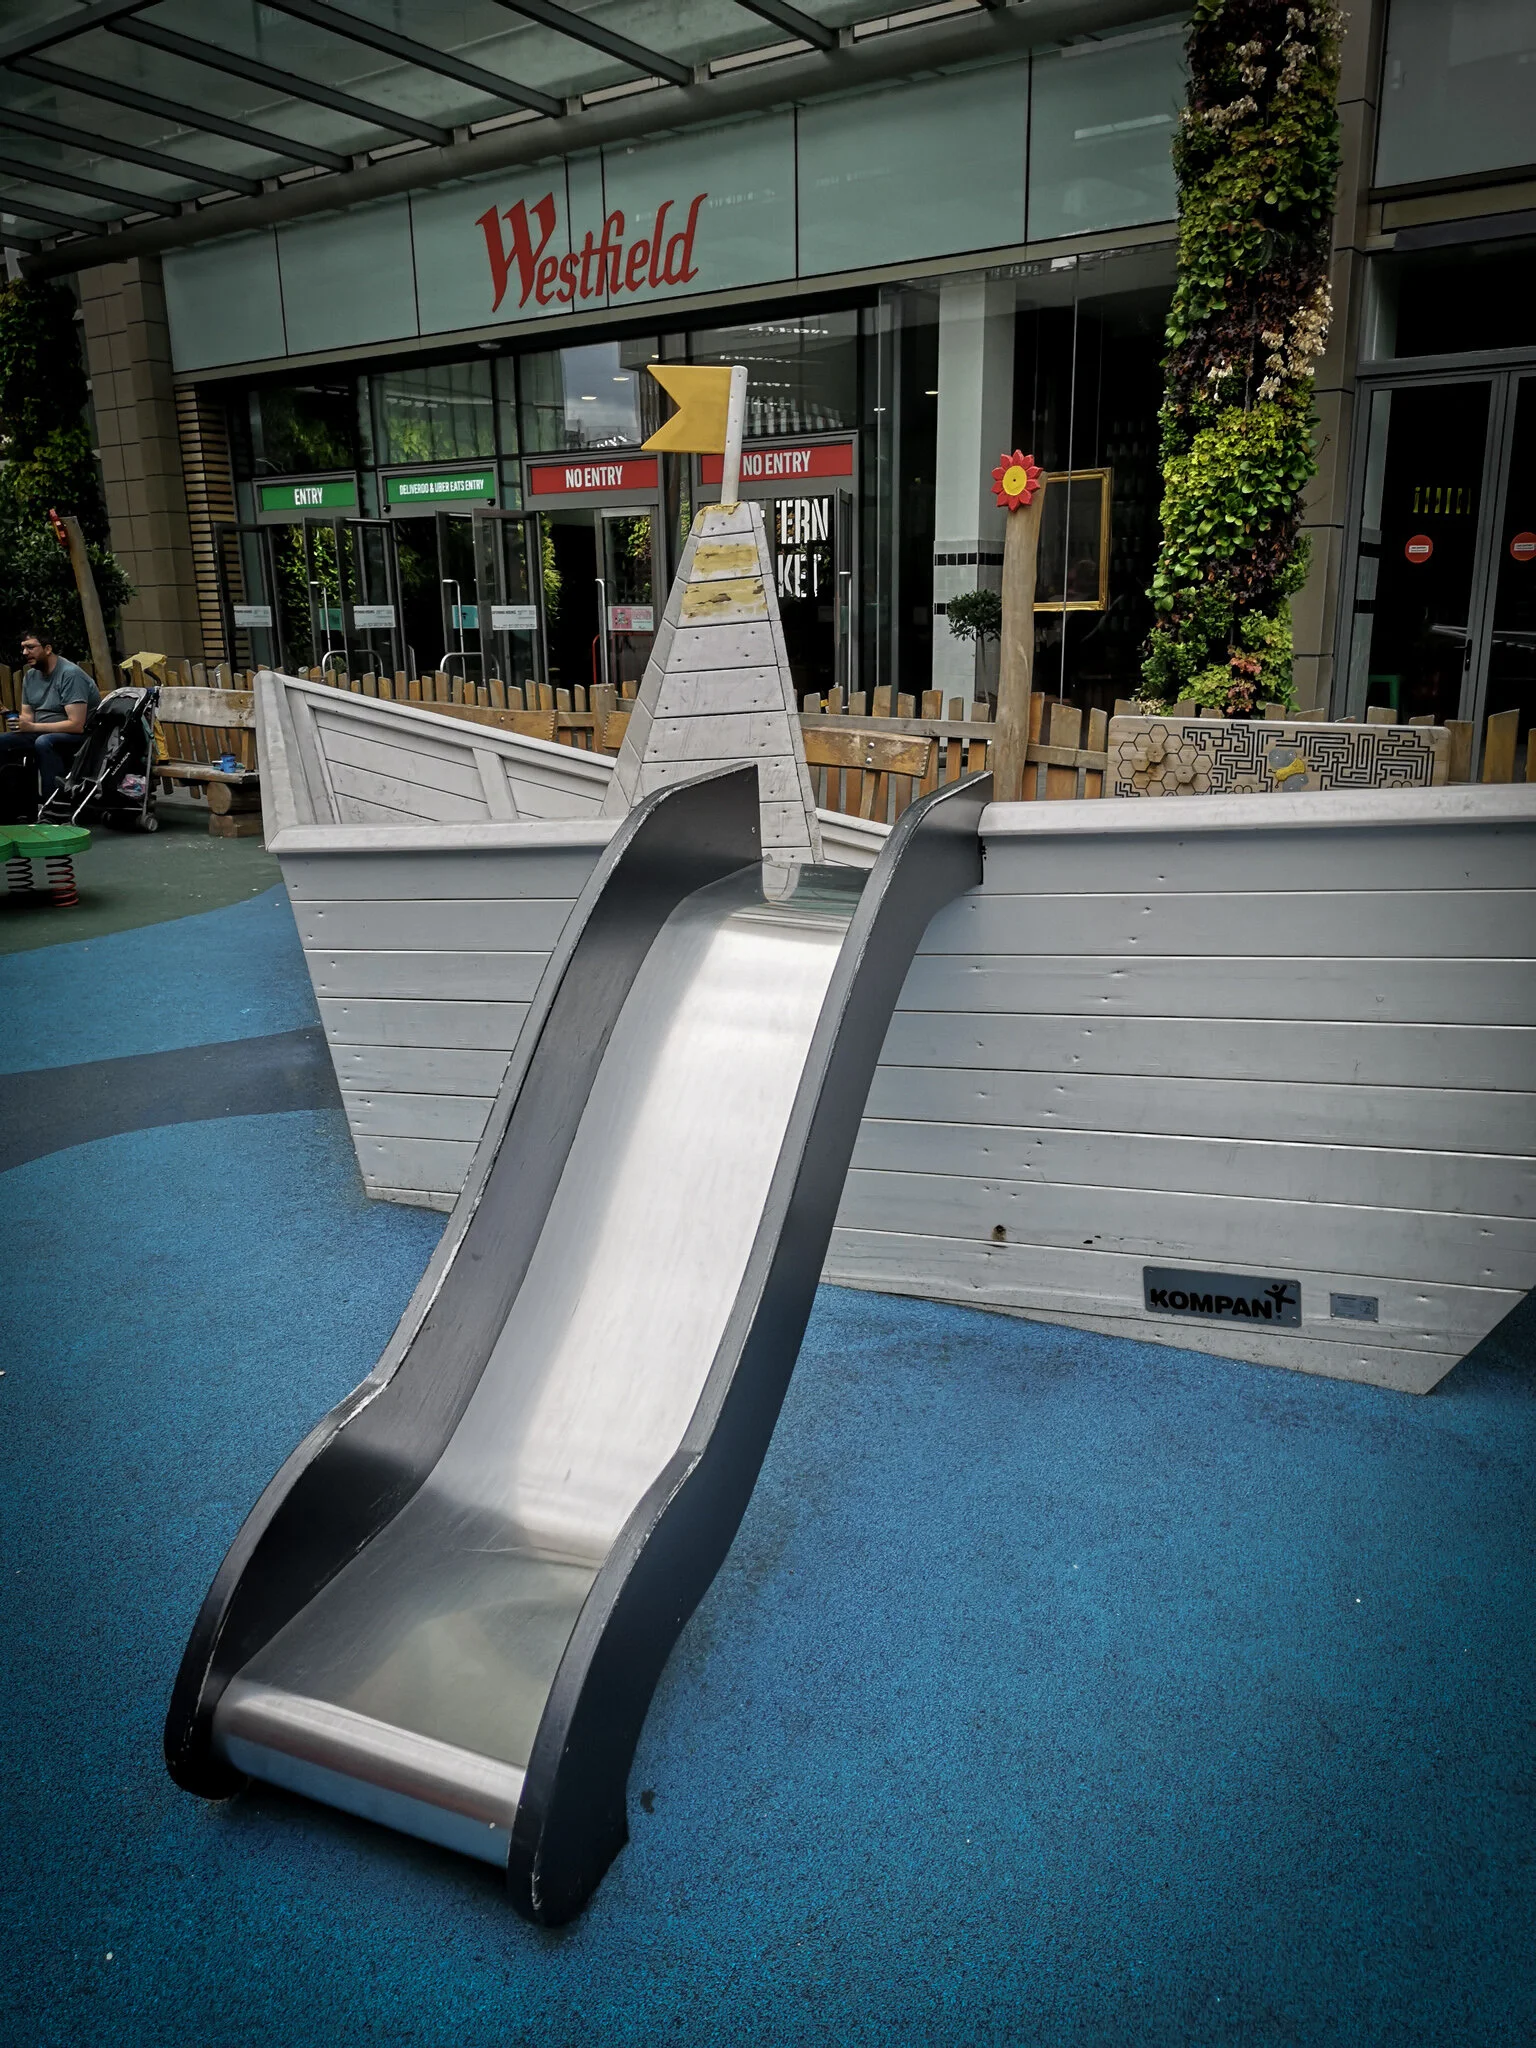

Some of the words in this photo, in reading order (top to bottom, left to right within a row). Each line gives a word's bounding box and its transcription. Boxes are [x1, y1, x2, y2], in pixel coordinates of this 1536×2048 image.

[475, 191, 708, 313] Westfield
[742, 453, 762, 476] NO
[765, 450, 811, 475] ENTRY
[399, 483, 429, 496] DELIVEROO
[429, 482, 435, 494] &
[434, 481, 450, 493] UBER
[450, 480, 465, 492] EATS
[465, 479, 484, 491] ENTRY
[565, 468, 583, 489] NO
[584, 465, 623, 488] ENTRY
[294, 487, 323, 506] ENTRY
[775, 498, 829, 545] ERN
[1150, 1288, 1273, 1320] KOMPAN
